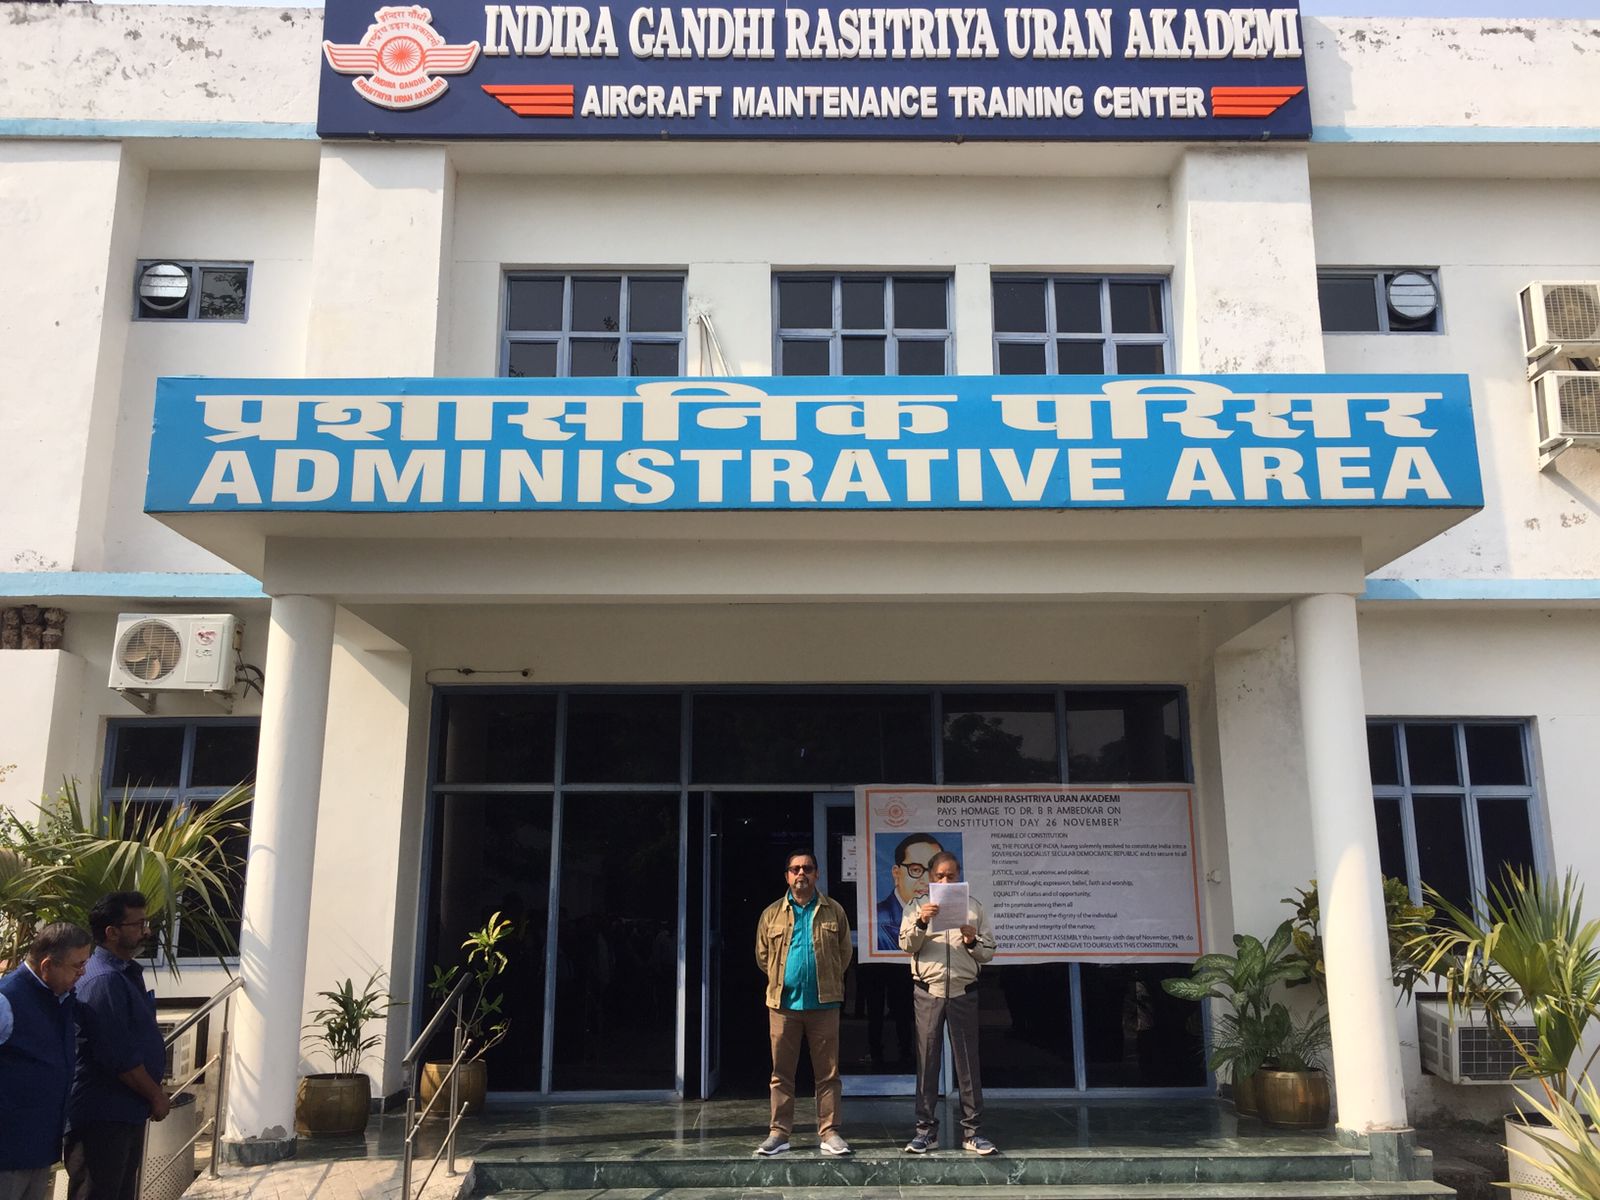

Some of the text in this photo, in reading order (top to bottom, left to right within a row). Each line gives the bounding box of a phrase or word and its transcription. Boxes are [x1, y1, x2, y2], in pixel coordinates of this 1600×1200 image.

[483, 5, 1302, 58] INDIRA GANDHI RASHTRIYA URAN AKADEMI
[357, 79, 444, 103] RASHTRIYA URAN AKADEMI
[373, 76, 426, 89] INDIRA GANDHI
[581, 85, 1206, 118] AIRCRAFT MAINTENANCE TRAINING CENTER
[195, 379, 1443, 442] प्रशासनिक परिसर
[189, 446, 1452, 503] ADMINISTRATIVE AREA
[936, 795, 1121, 803] INDIRA GANDHI RASHTRIYA URAN AKADEMI
[937, 806, 1121, 815] PAYS HOMAGE TO DR. B R AMBEDKAR ON
[937, 818, 1014, 827] CONSTITUTION
[1020, 818, 1040, 827] DAY
[1046, 818, 1057, 827] 26
